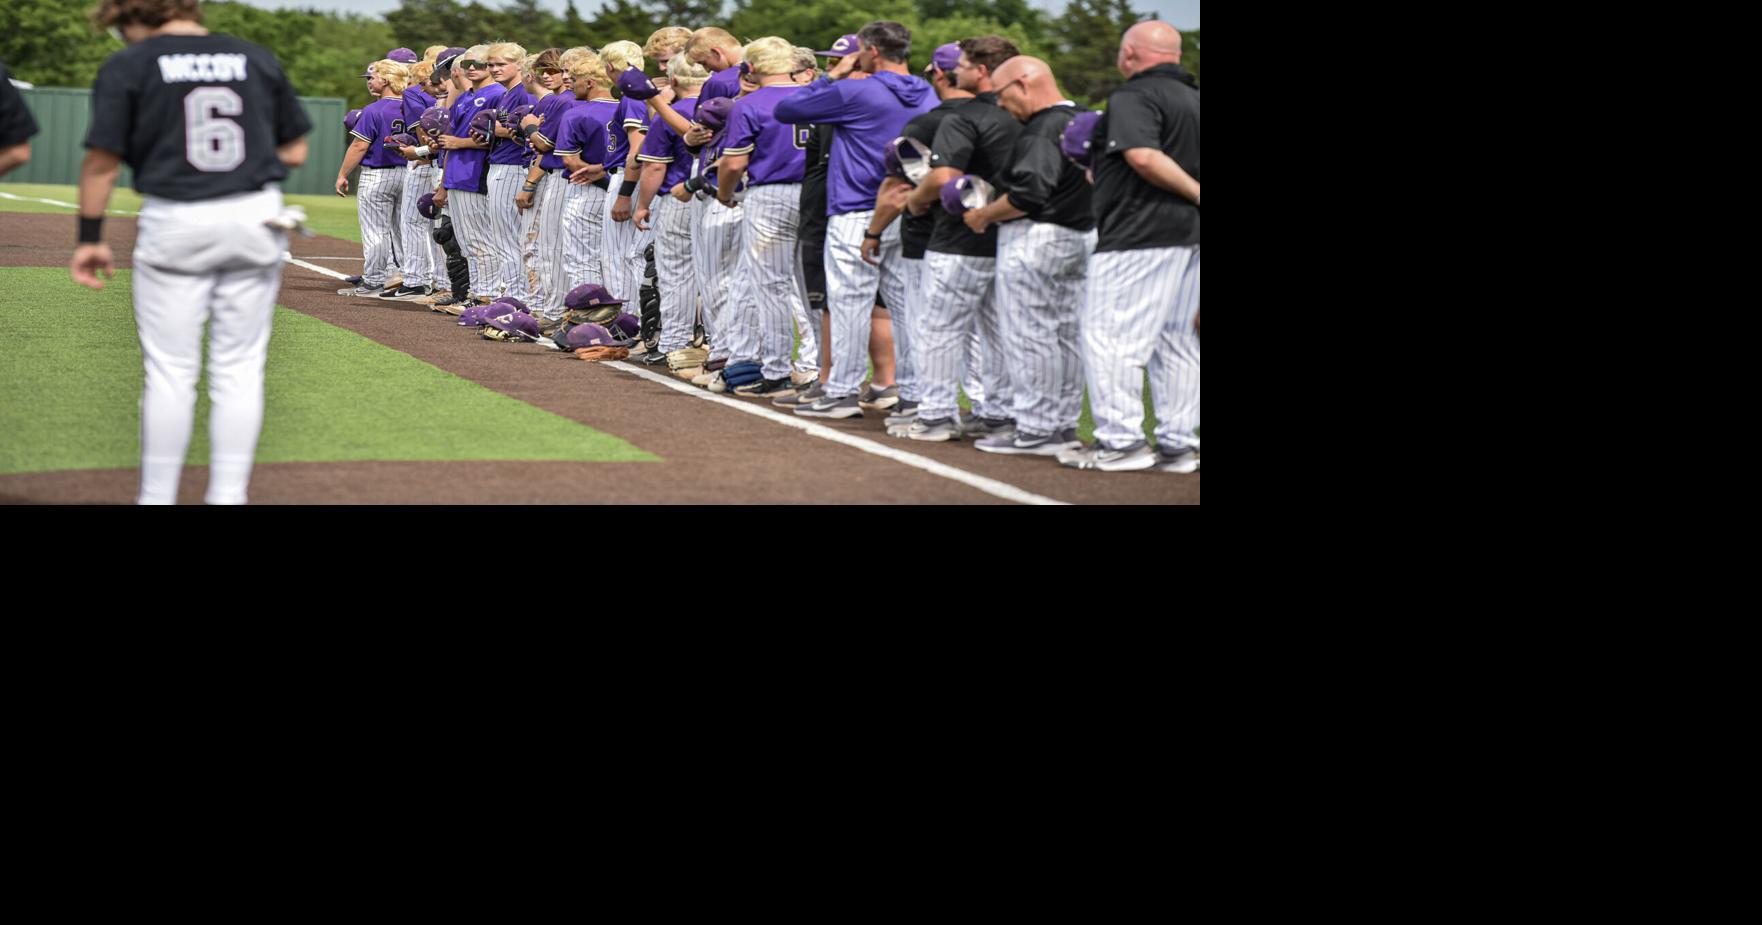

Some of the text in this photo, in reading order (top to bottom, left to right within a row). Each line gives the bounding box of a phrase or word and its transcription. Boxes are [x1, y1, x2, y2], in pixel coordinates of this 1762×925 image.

[832, 38, 850, 51] C
[158, 53, 248, 84] MCCOY
[474, 97, 486, 107] C
[184, 86, 246, 172] 6
